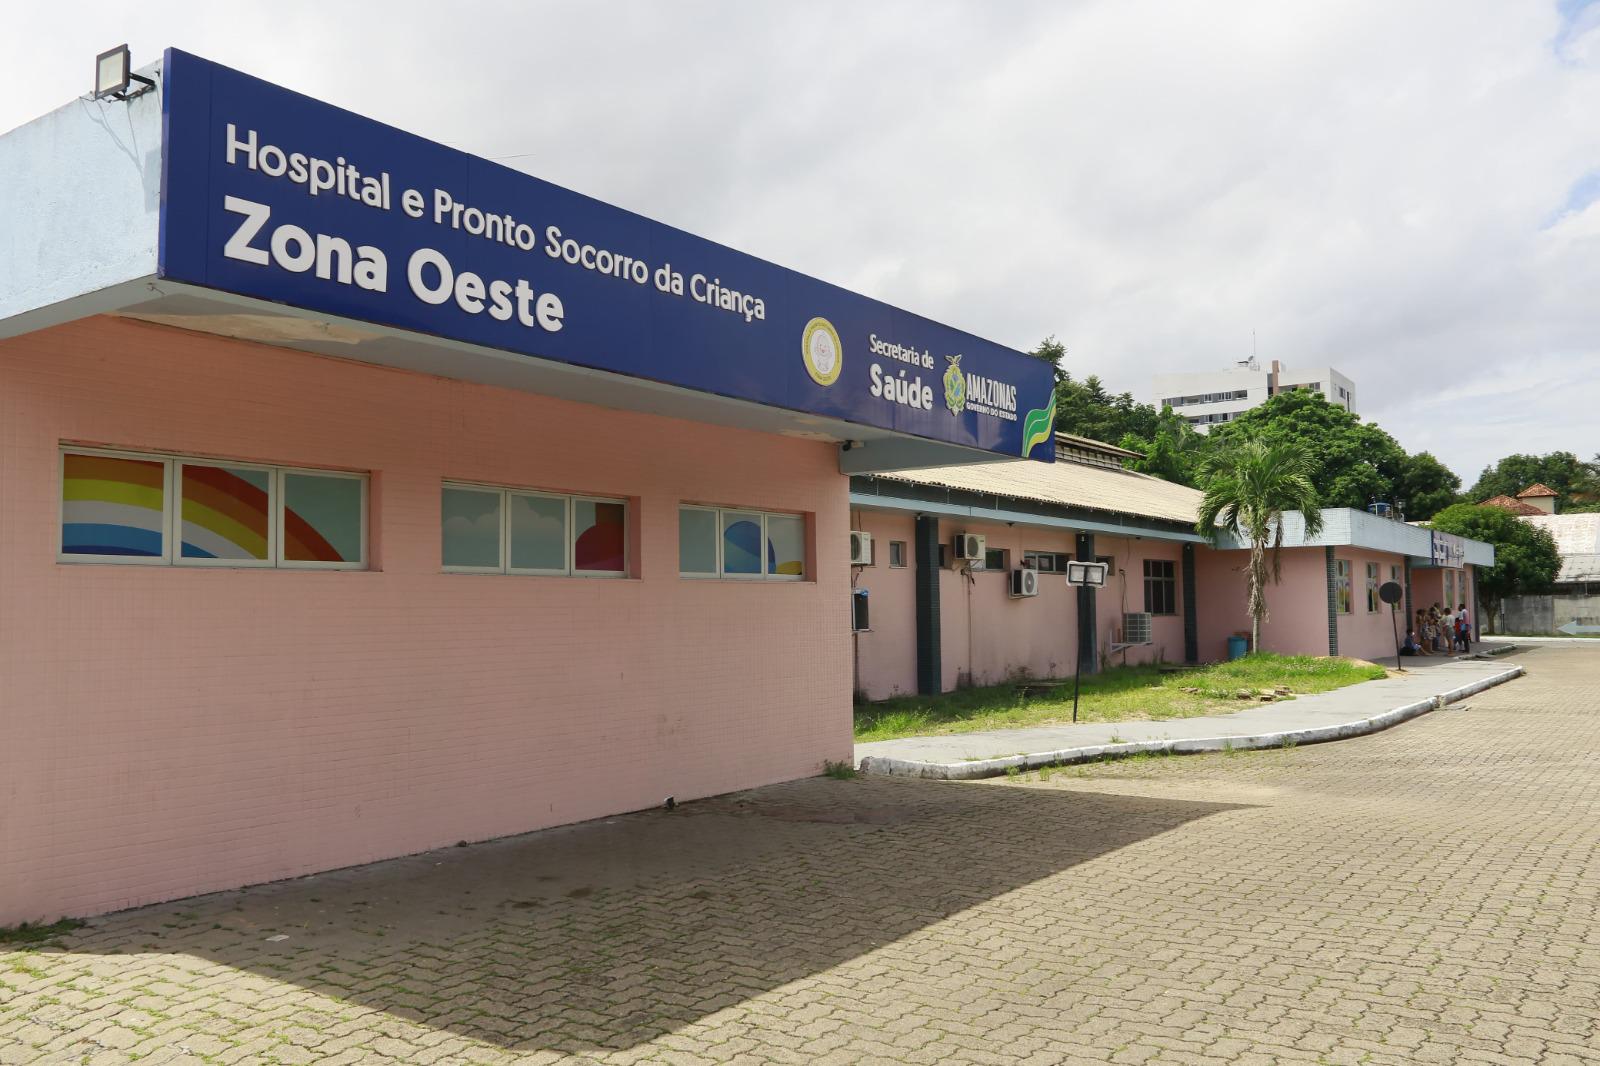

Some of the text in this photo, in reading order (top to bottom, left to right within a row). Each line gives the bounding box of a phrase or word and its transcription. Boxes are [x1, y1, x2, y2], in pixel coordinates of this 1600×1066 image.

[226, 123, 765, 323] Hospital e Pronto Socorro da Criança
[224, 195, 565, 332] Zona Oeste
[869, 333, 920, 366] Secretaria
[921, 350, 935, 370] de
[869, 363, 934, 411] Saúde
[966, 372, 1017, 412] AMAZONAS
[966, 401, 990, 415] GOVERNO
[990, 408, 999, 417] DO
